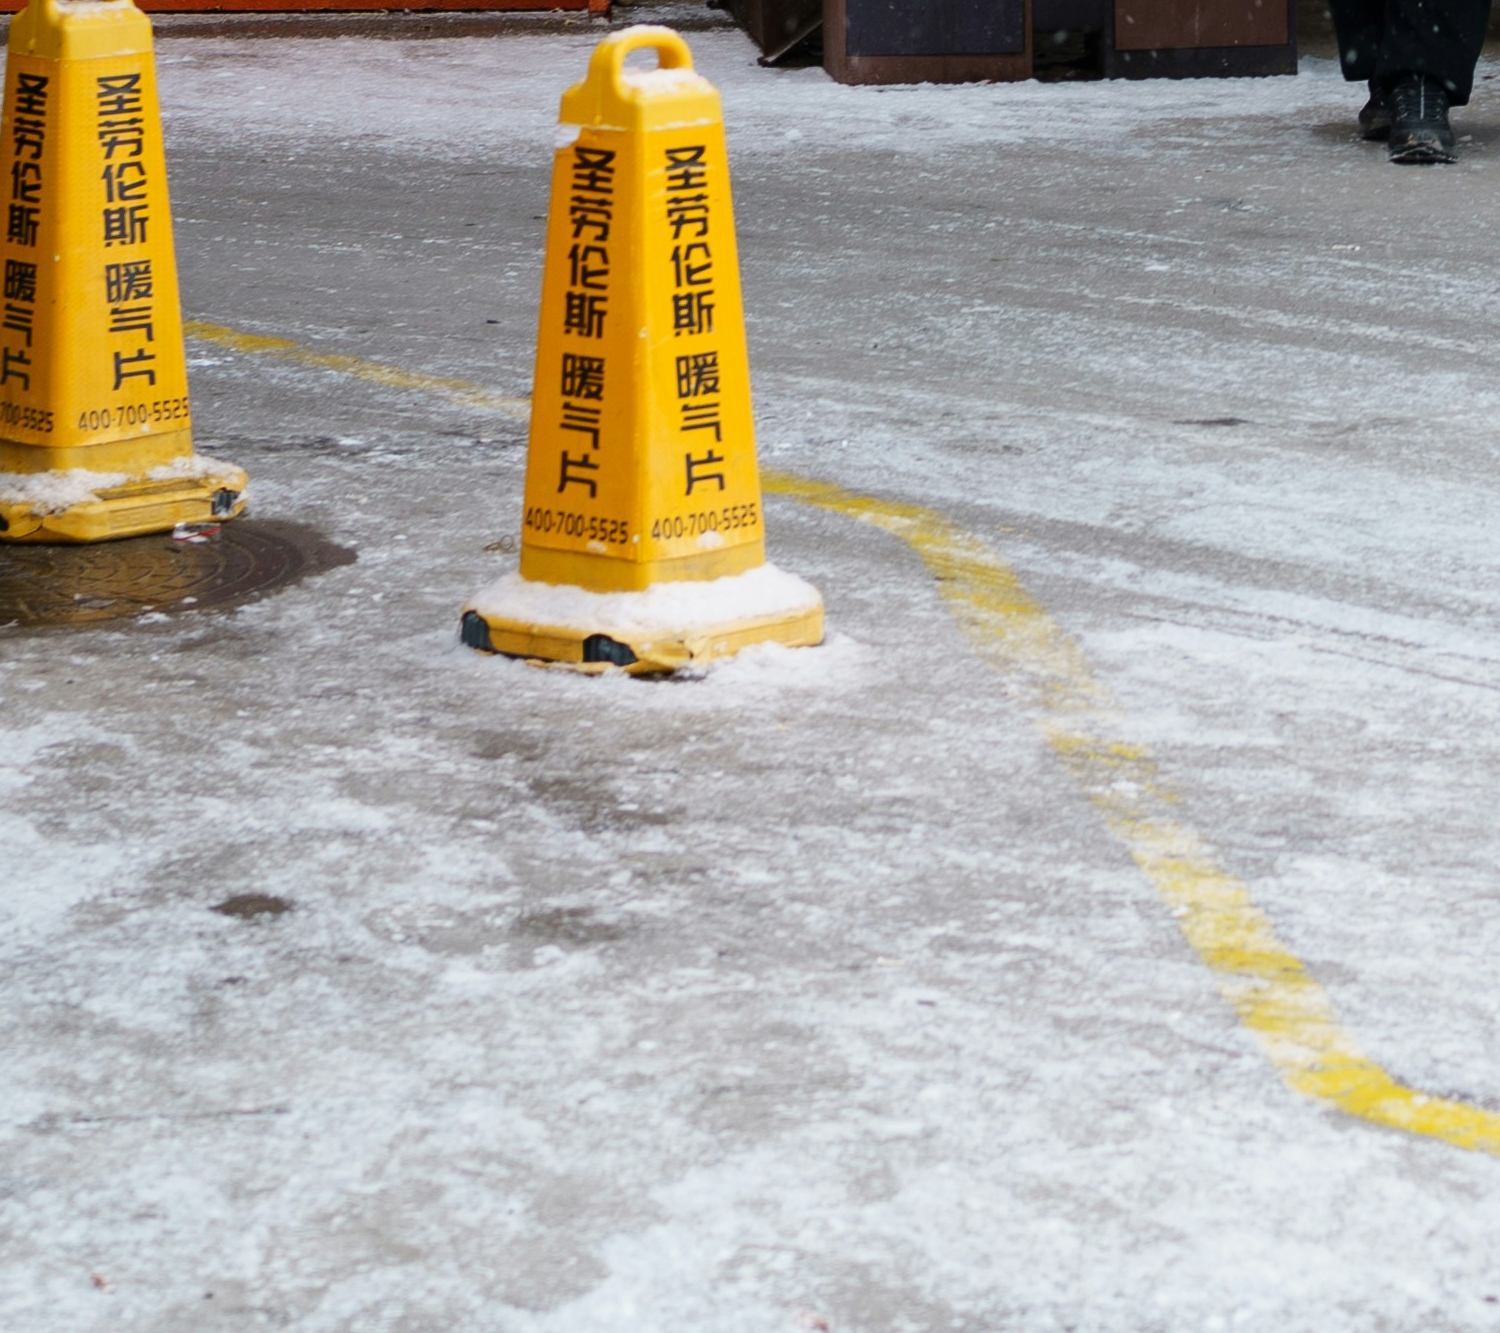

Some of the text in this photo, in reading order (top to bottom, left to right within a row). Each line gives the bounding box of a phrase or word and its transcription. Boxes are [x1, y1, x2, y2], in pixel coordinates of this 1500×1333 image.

[0, 72, 49, 391] 圣劳伦斯 暖气片
[96, 73, 156, 391] 圣劳伦斯 暖气片
[557, 145, 616, 499] 圣劳伦斯 暖气片
[664, 144, 725, 497] 圣劳伦斯 暖气片
[77, 396, 190, 433] 400-700-5525
[524, 505, 629, 545] 400-700-5525
[651, 502, 758, 541] 400-700-5525
